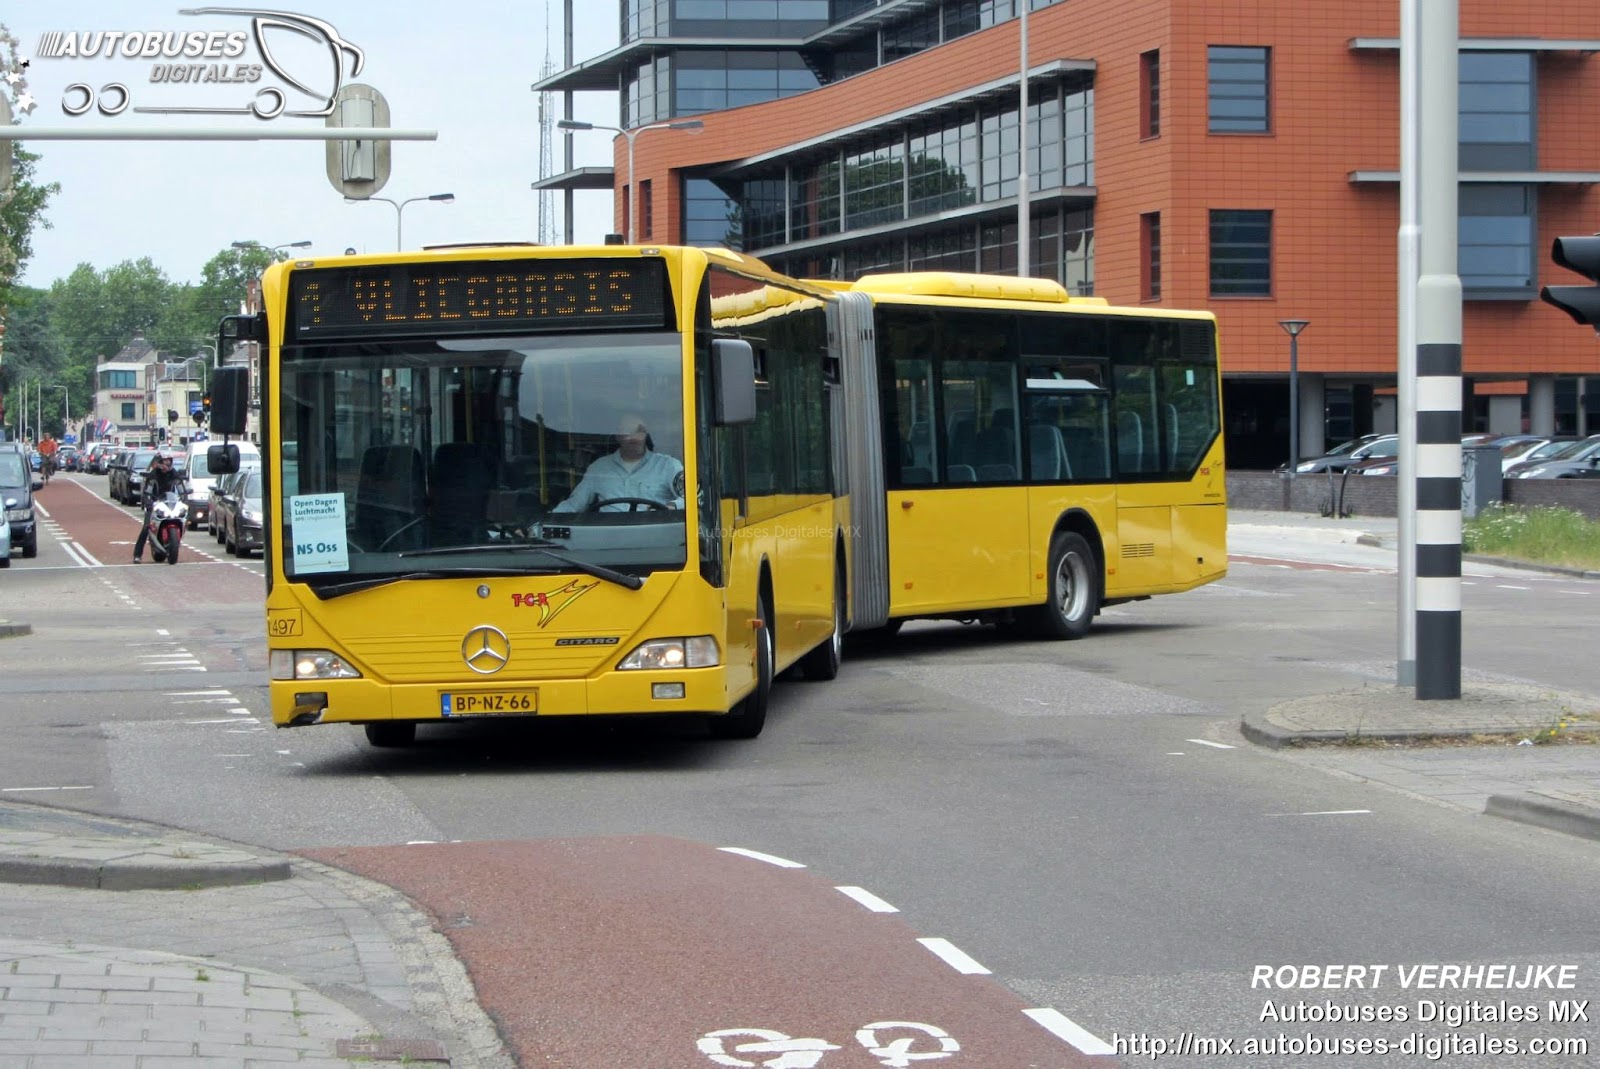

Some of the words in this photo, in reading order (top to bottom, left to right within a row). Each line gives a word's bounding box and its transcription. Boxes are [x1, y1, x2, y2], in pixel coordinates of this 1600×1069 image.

[294, 500, 314, 509] Open
[315, 499, 338, 507] Dagen
[294, 507, 336, 516] Luchtmacht
[296, 543, 314, 555] NS
[316, 542, 338, 553] Oss
[272, 618, 297, 635] 497
[557, 637, 618, 646] CITARO
[456, 695, 530, 711] BP-NZ-66
